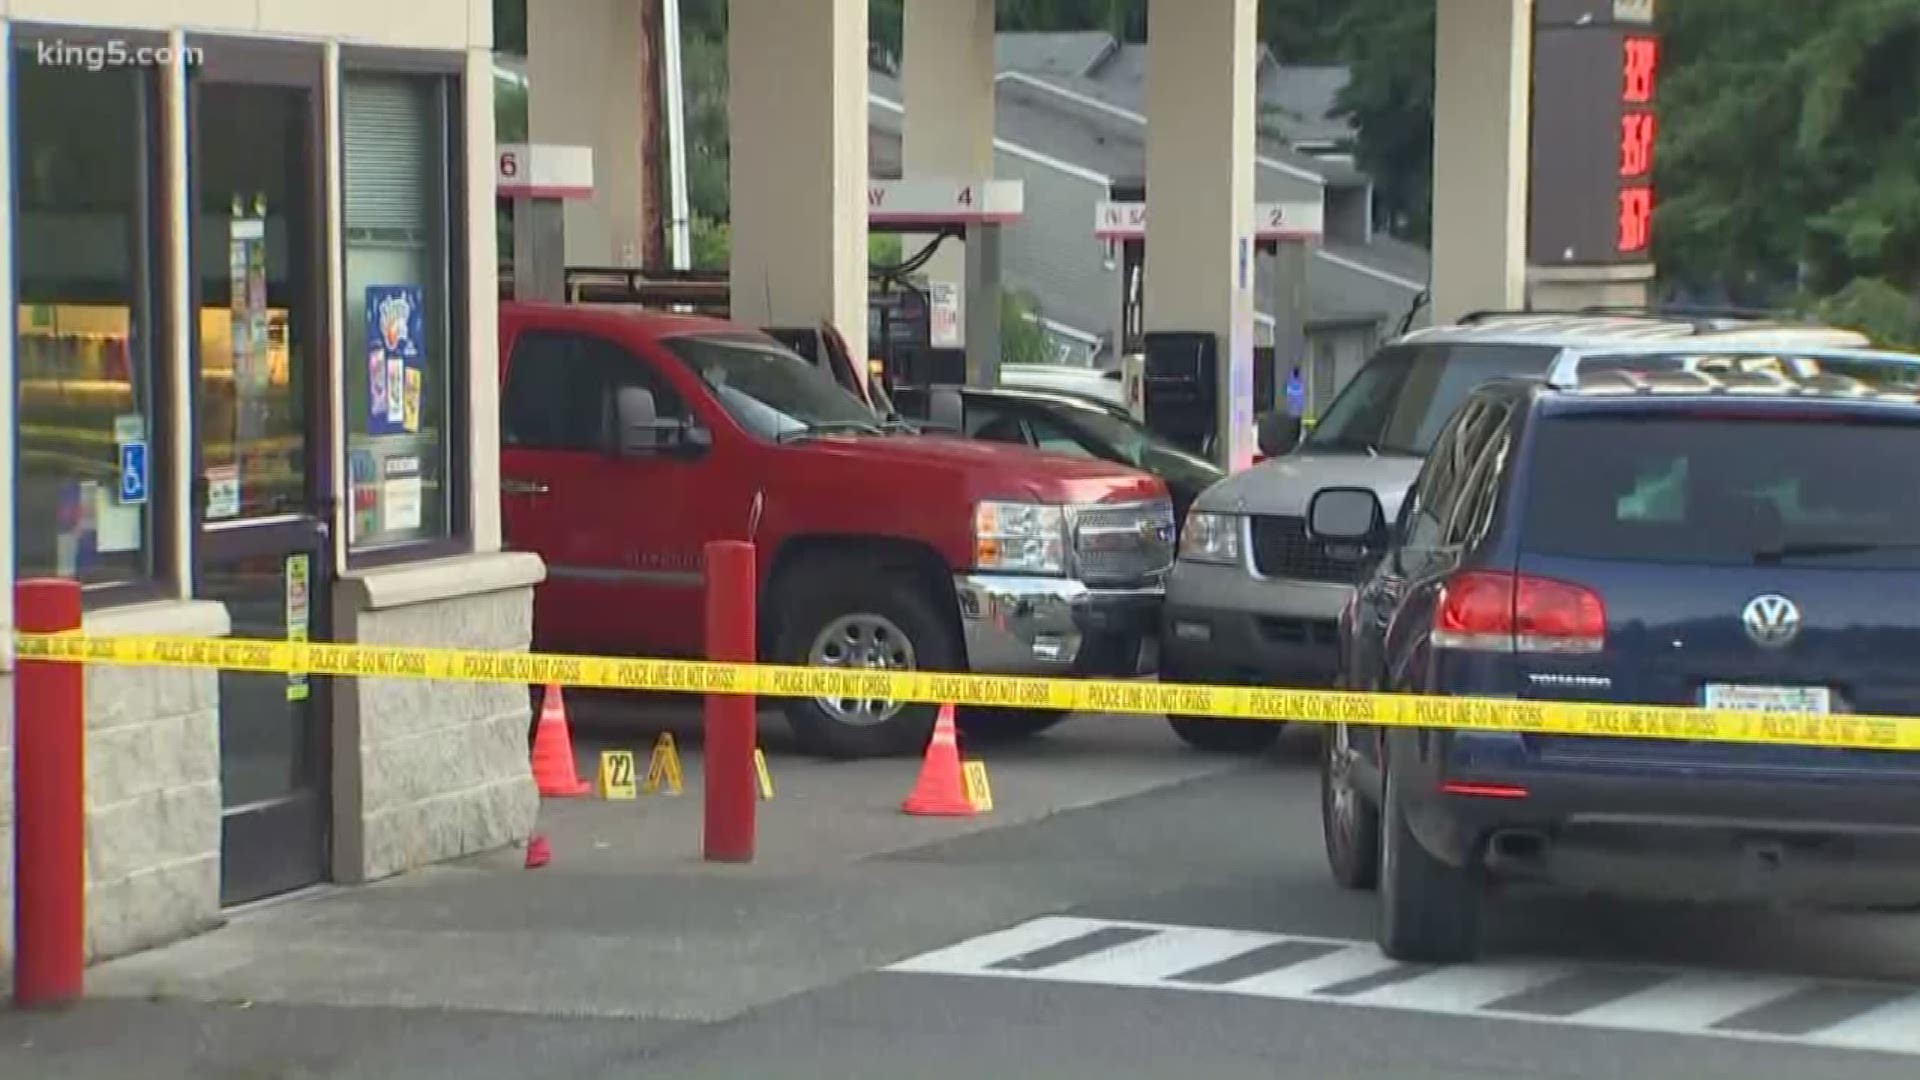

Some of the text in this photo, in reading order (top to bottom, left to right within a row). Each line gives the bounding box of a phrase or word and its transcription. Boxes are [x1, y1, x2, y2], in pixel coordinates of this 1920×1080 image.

[500, 152, 517, 176] 6
[957, 187, 973, 207] 4
[1269, 208, 1283, 228] 2
[464, 656, 580, 681] POLICE LINE DO NOT CROSS
[618, 662, 735, 689] POLICE LINE DO NOT CROSS
[774, 671, 891, 697] POLICE LINE DO NOT CROSS
[930, 678, 1049, 704] POLICE LINE DO NOT CROSS
[1089, 685, 1212, 711] POLICE LINE DO NOT CROSS
[1250, 693, 1374, 720] POLICE LINE DO NOT CROSS
[1416, 700, 1447, 722] POLICE
[1450, 701, 1470, 723] LINE
[608, 754, 633, 787] 22
